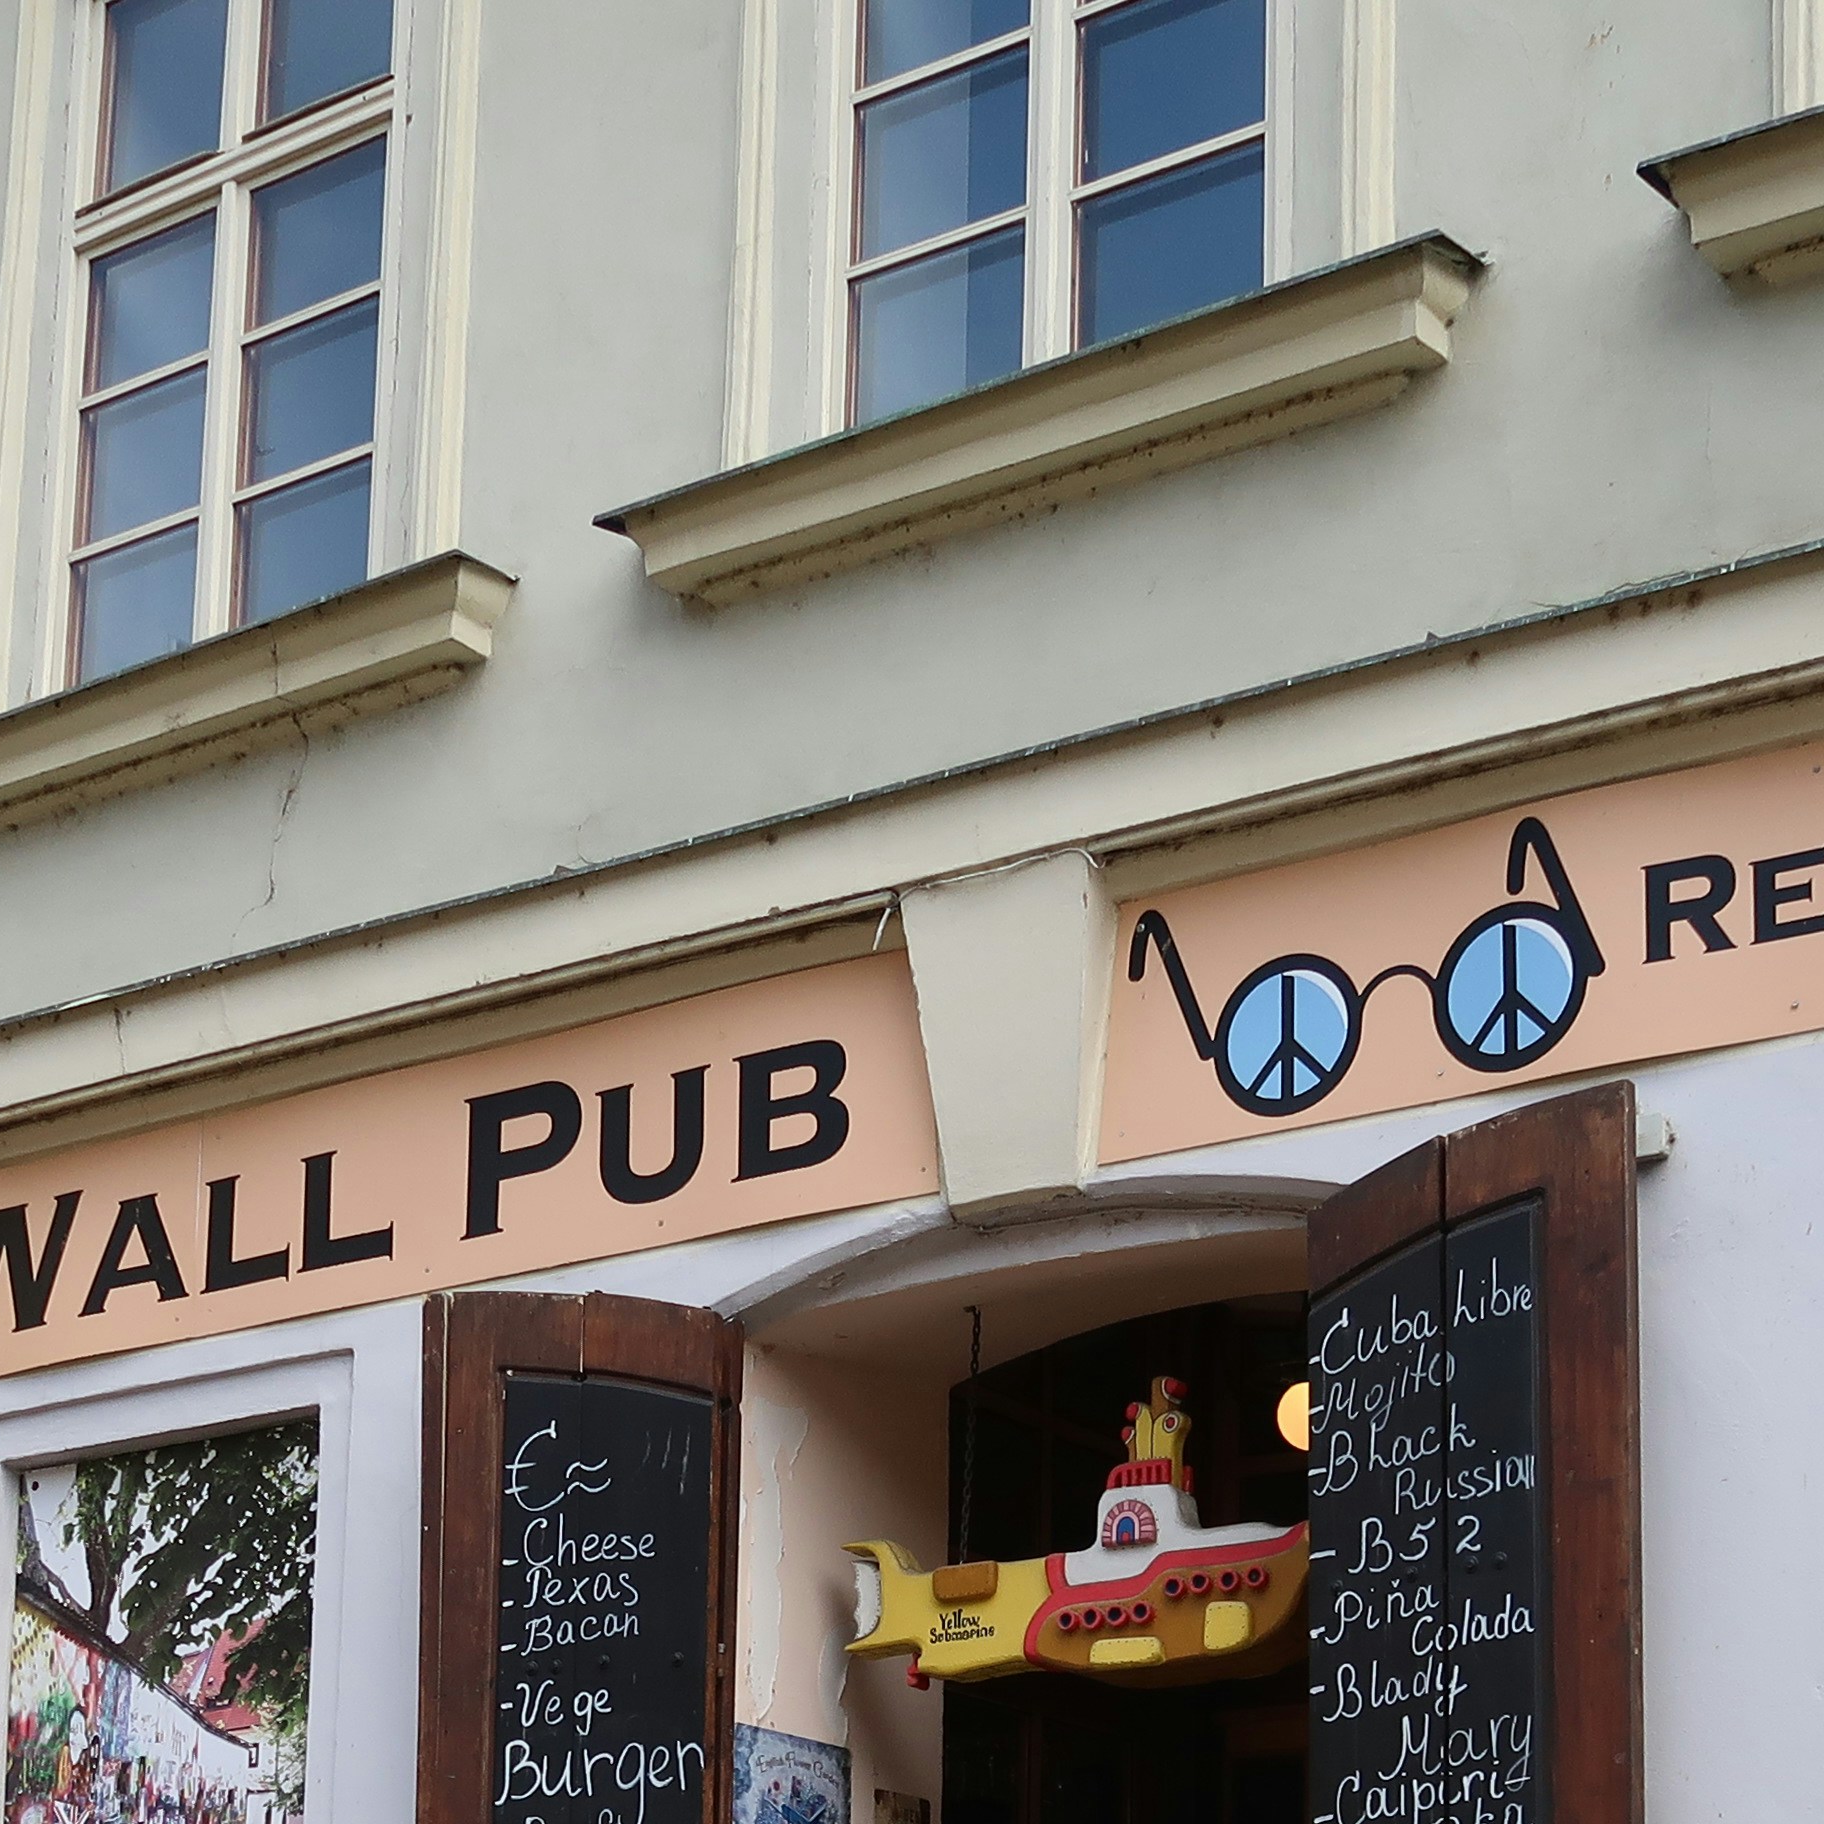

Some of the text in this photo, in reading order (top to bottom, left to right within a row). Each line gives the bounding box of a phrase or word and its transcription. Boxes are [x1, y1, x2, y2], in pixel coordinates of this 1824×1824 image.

[460, 1038, 851, 1241] PUB
[1321, 1294, 1438, 1375] Cuba
[524, 1513, 655, 1566] Cheese
[523, 1564, 639, 1608] Texas
[939, 1608, 981, 1631] Yellow
[1412, 1594, 1535, 1656] Colada
[516, 1680, 612, 1735] Vege
[1378, 1713, 1532, 1792] Mary
